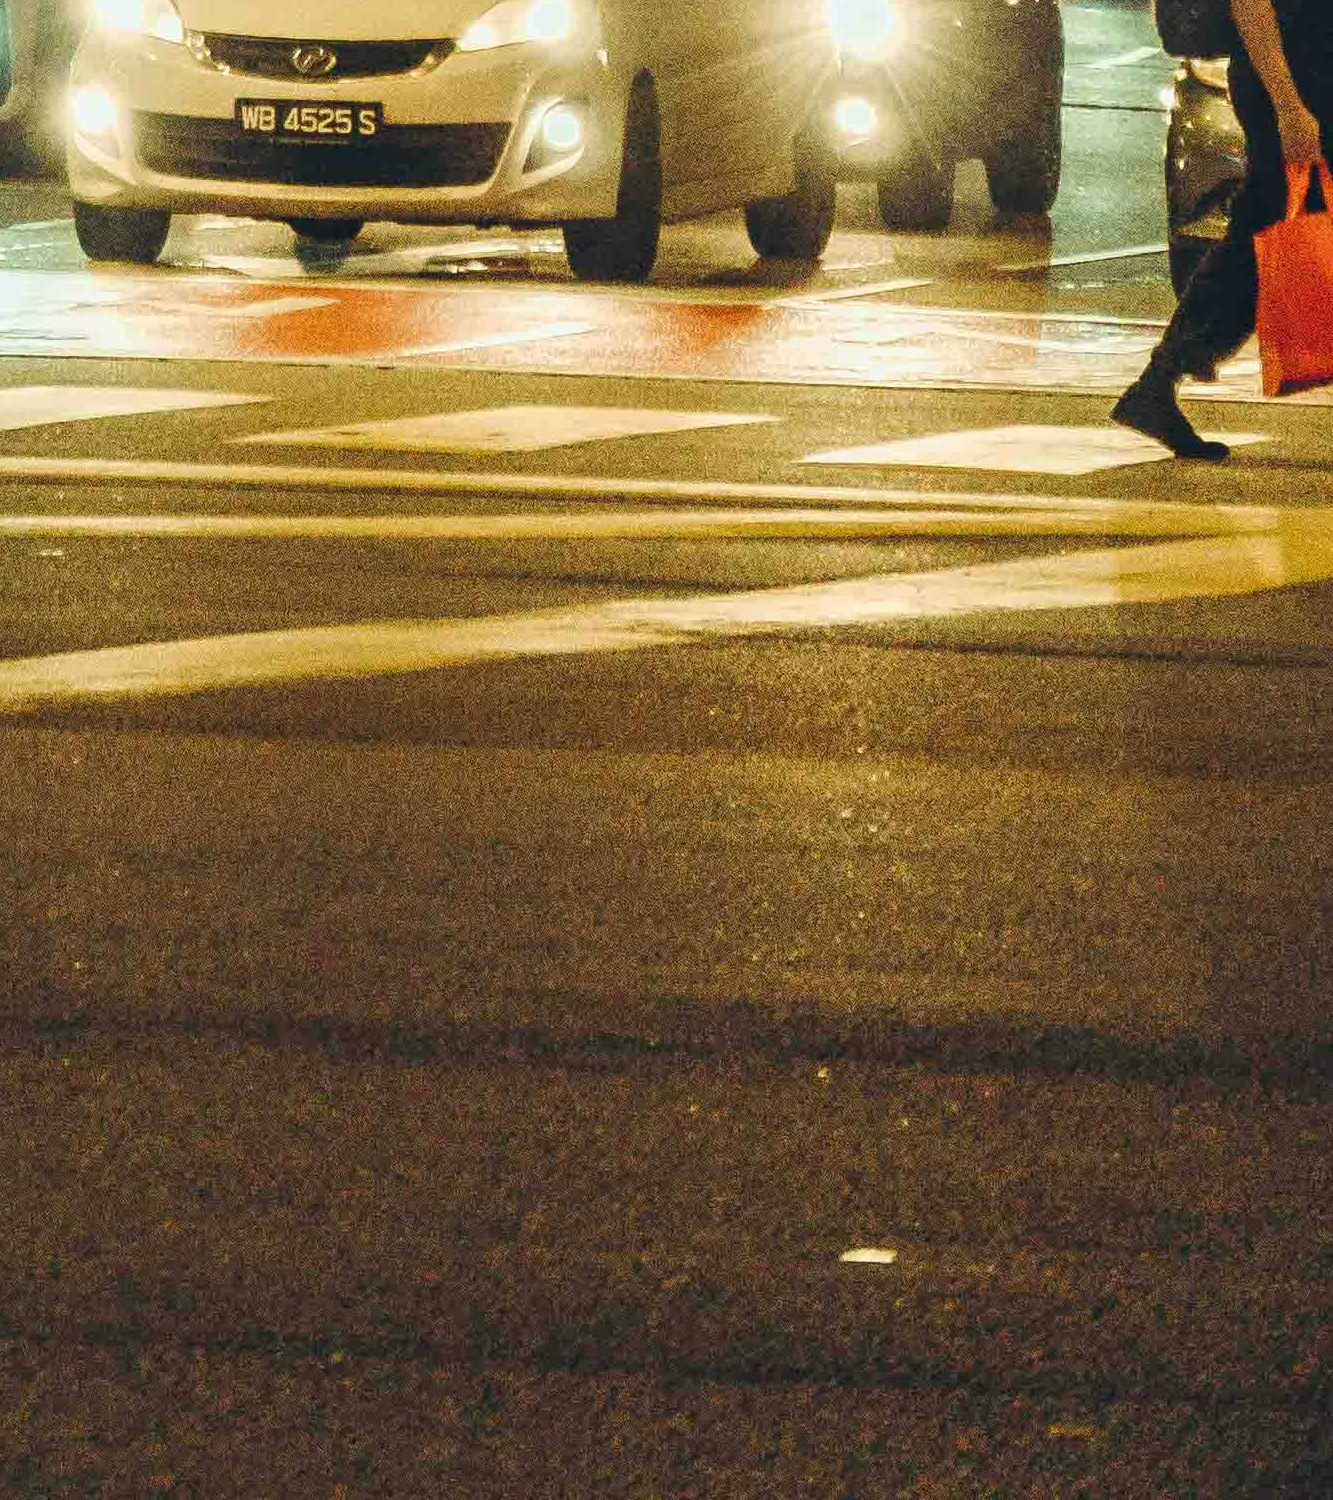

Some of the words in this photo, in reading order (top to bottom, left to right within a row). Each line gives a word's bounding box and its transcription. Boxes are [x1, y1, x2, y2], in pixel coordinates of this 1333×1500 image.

[241, 106, 277, 132] WB
[283, 107, 353, 134] 4525
[358, 108, 376, 135] S
